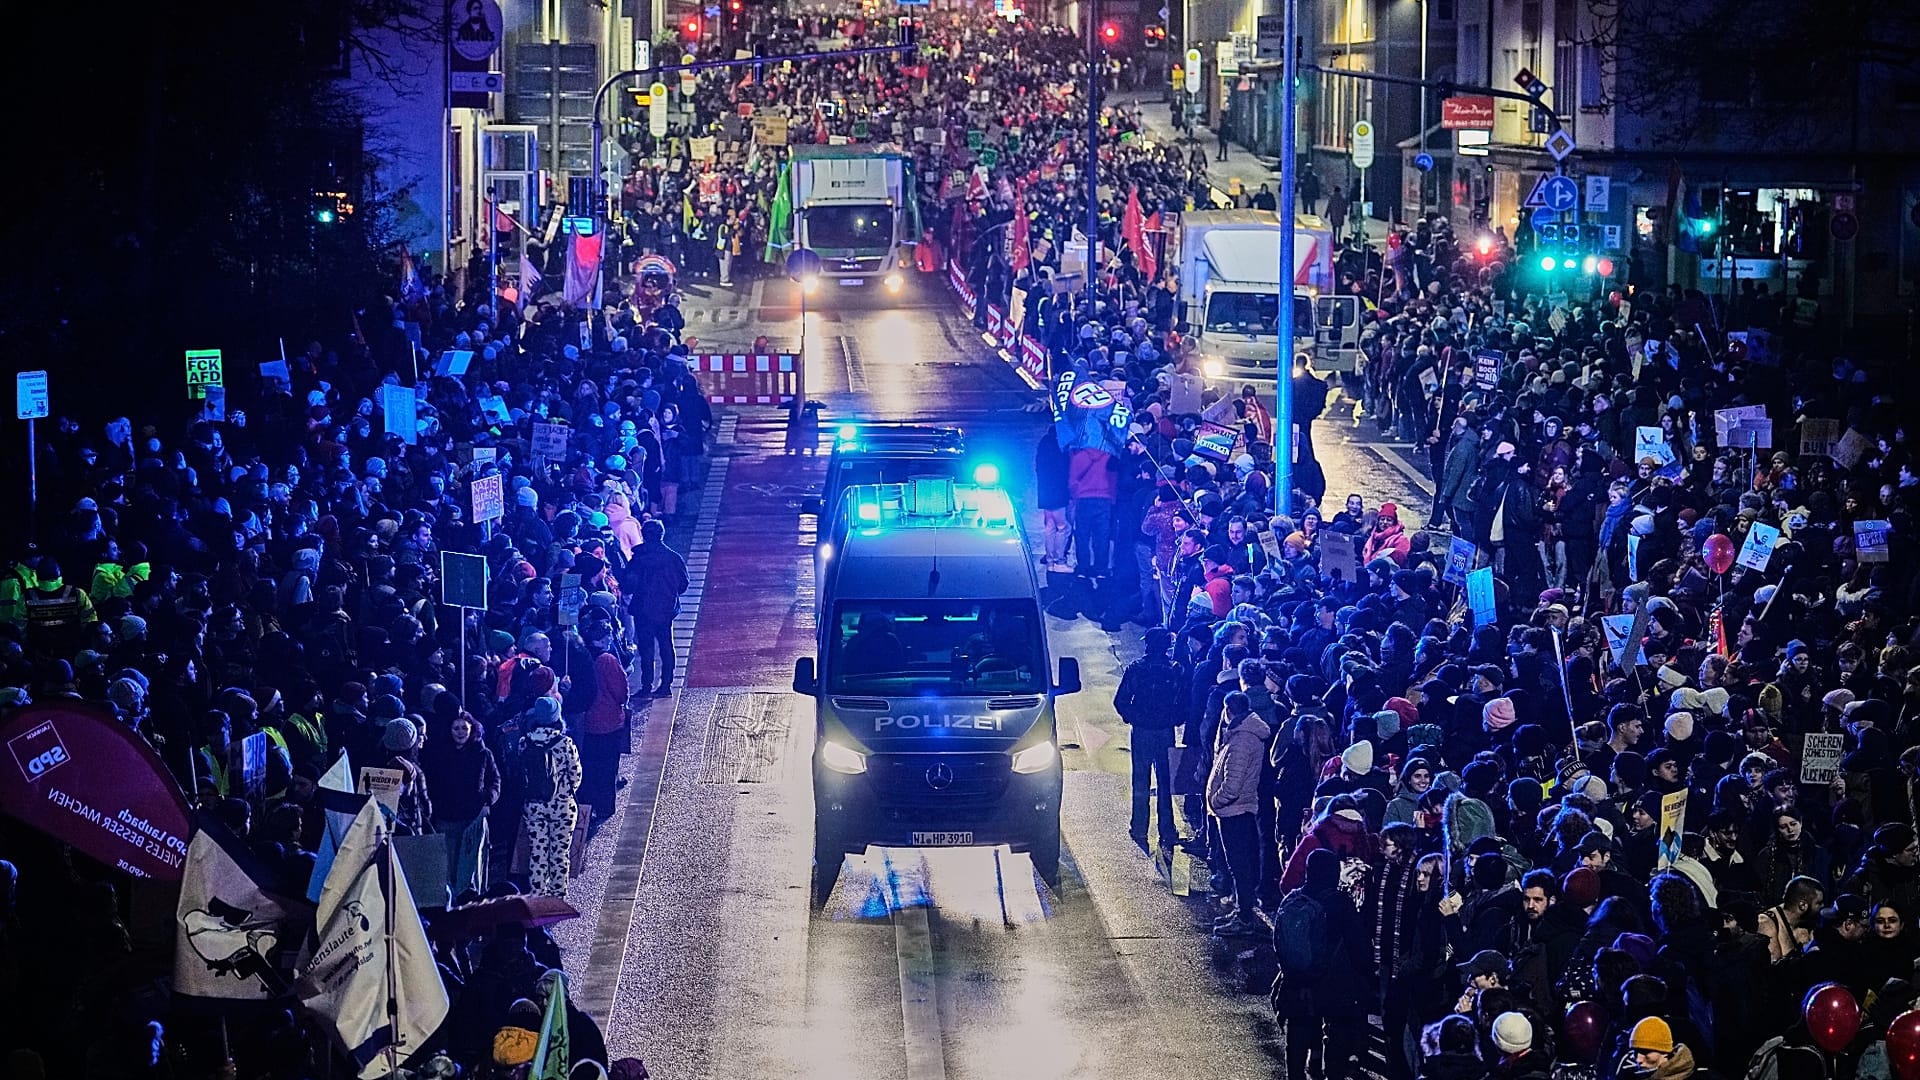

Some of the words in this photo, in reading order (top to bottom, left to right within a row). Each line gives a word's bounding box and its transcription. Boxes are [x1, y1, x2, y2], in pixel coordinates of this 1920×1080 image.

[187, 359, 220, 372] FCK
[189, 371, 221, 383] AFD
[1803, 441, 1836, 455] BUNT
[473, 498, 500, 513] NAZIS
[875, 714, 1003, 732] POLIZEI
[1807, 735, 1841, 749] SCHEREN
[932, 833, 946, 844] HP
[947, 833, 972, 844] 3910
